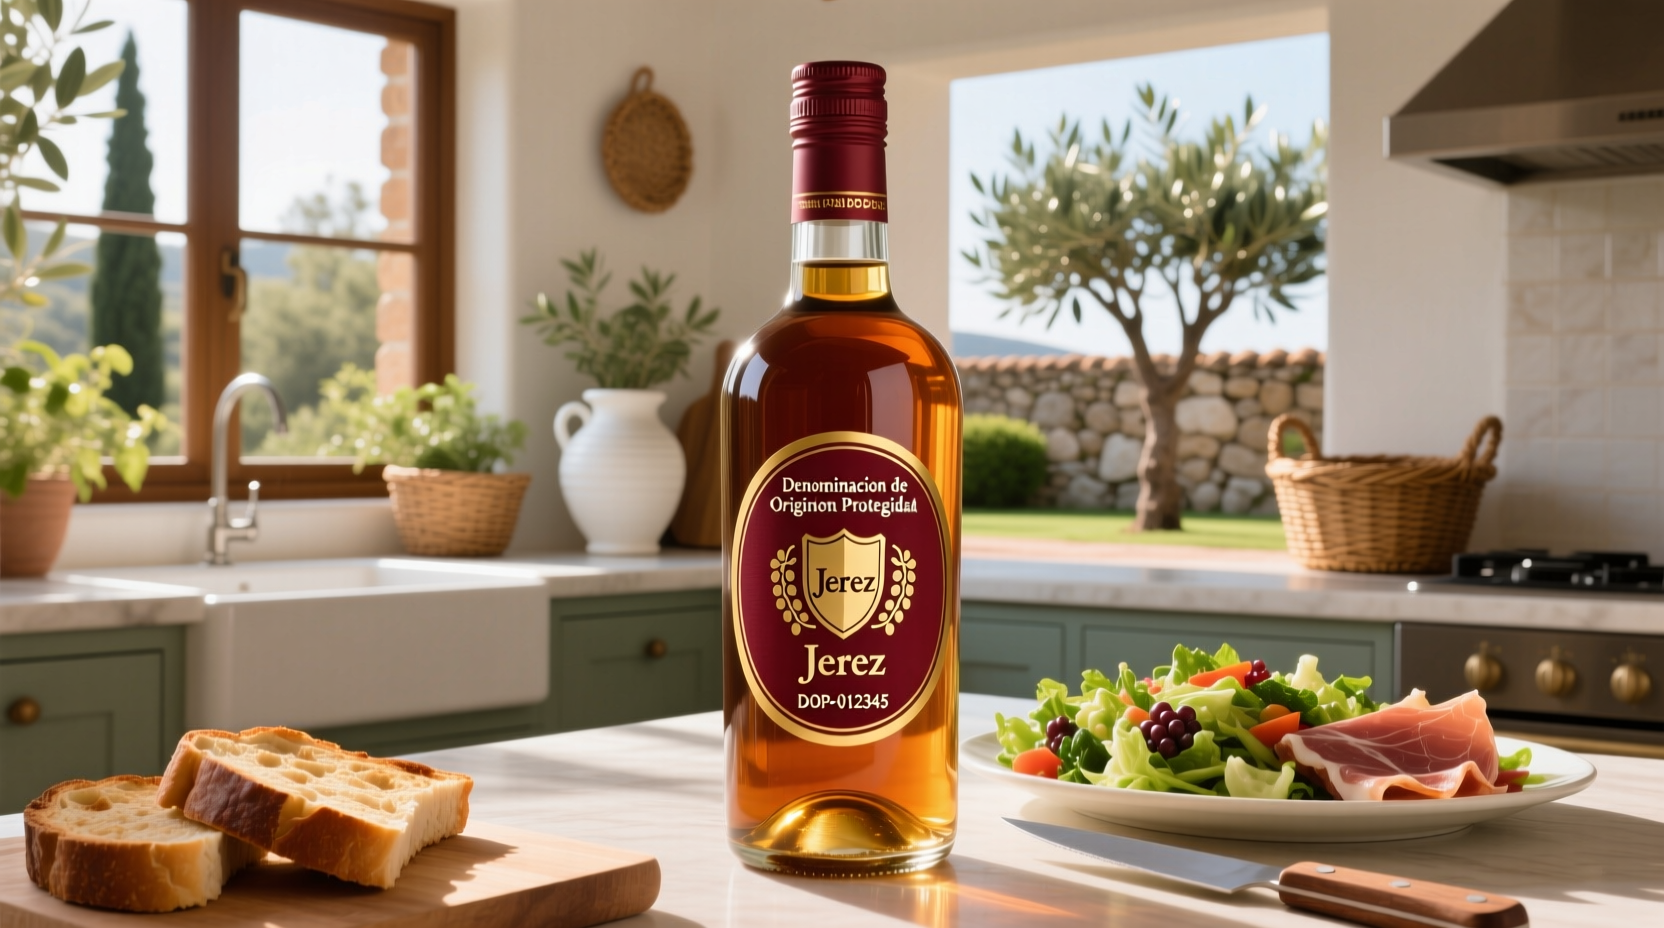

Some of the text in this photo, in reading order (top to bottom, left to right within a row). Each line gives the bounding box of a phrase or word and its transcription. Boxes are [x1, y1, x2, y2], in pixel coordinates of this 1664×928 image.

[783, 476, 908, 492] Denominacion de
[812, 568, 875, 598] Jerez
[798, 644, 886, 684] Jerez
[798, 694, 888, 709] DOP-012345
